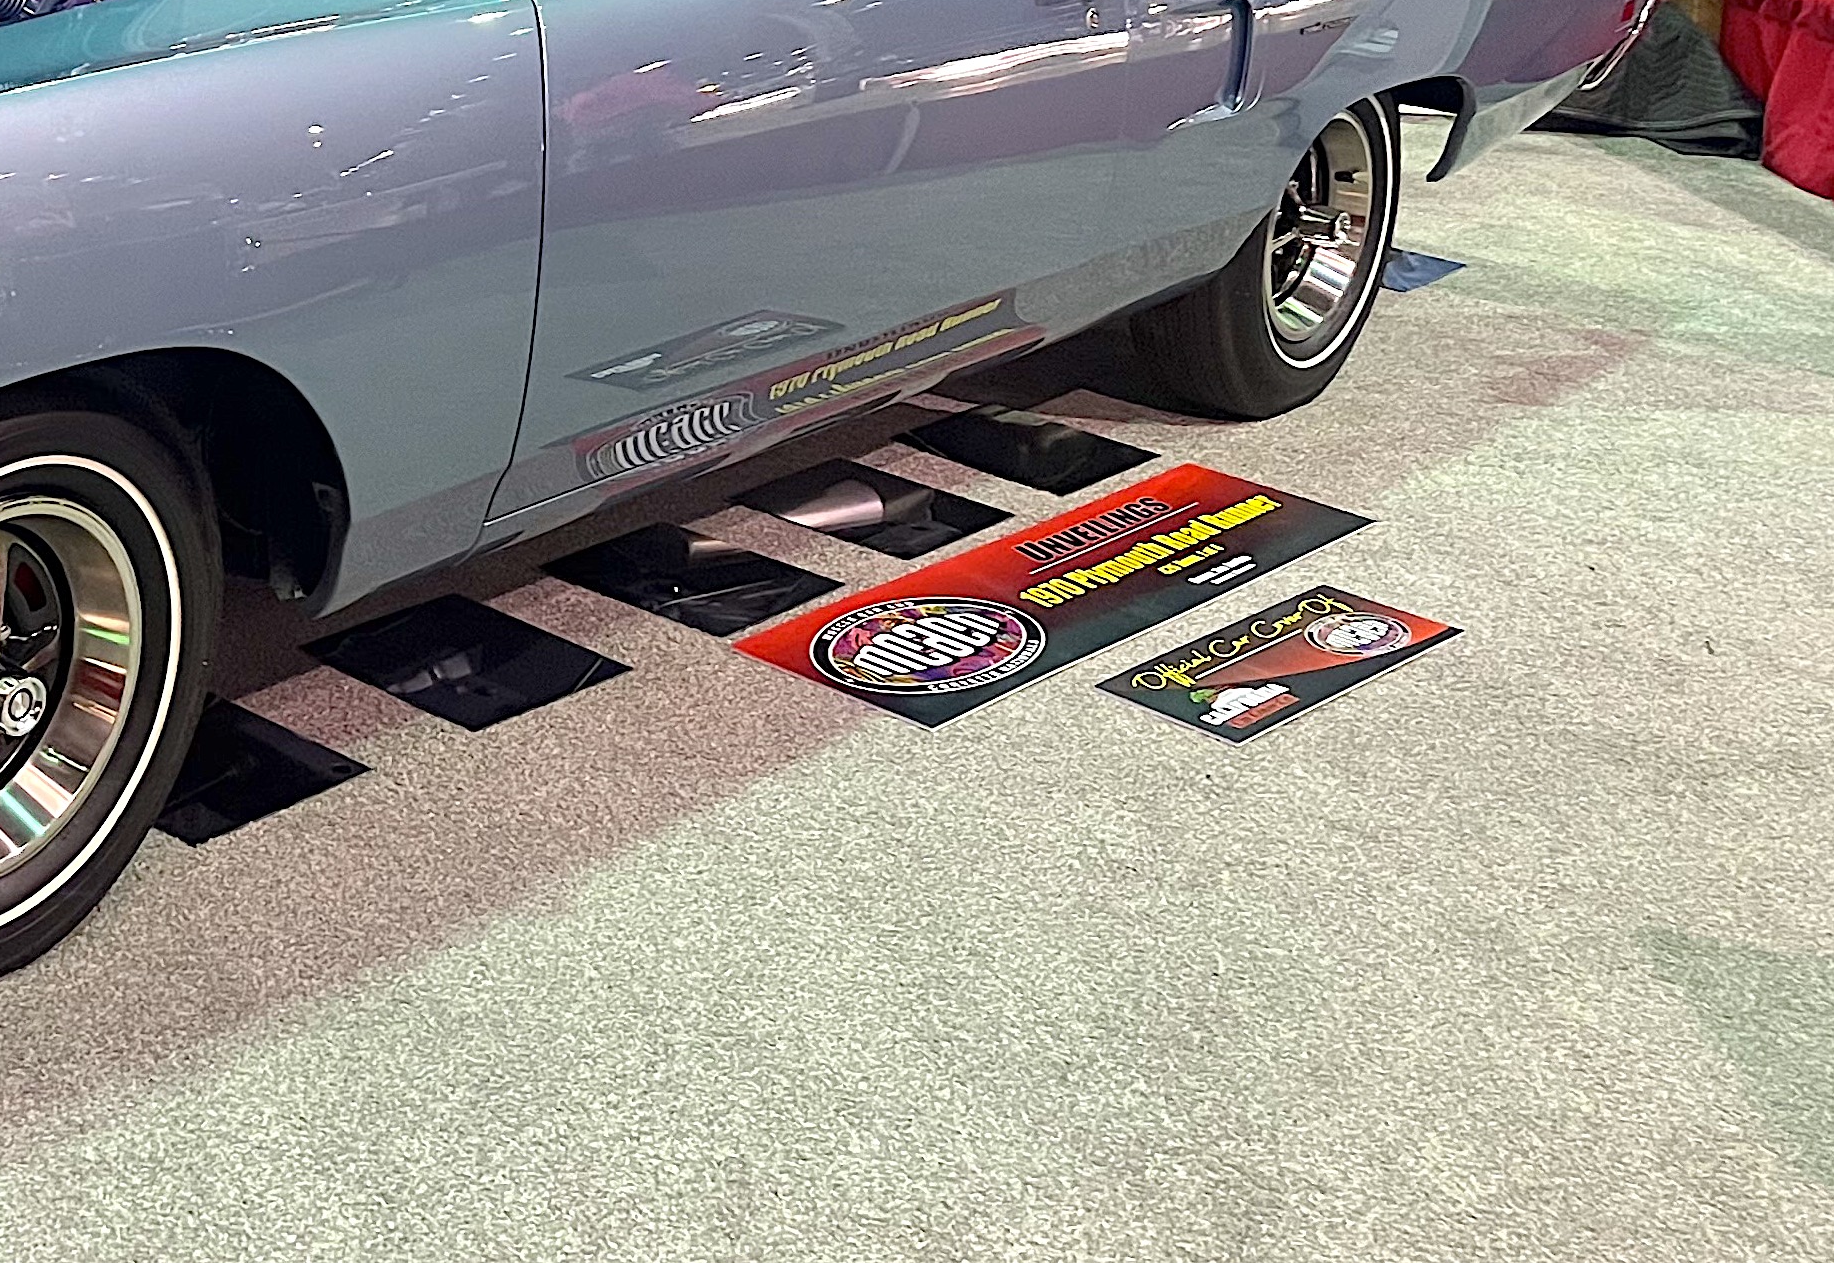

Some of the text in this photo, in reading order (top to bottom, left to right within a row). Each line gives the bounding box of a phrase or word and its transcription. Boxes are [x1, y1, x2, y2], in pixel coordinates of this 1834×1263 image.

[1020, 579, 1086, 608] 1970
[1063, 542, 1175, 584] Plymouth
[1151, 514, 1222, 551] Road
[1198, 495, 1283, 529] Runner
[1132, 650, 1212, 690] Official
[1208, 634, 1252, 658] Car
